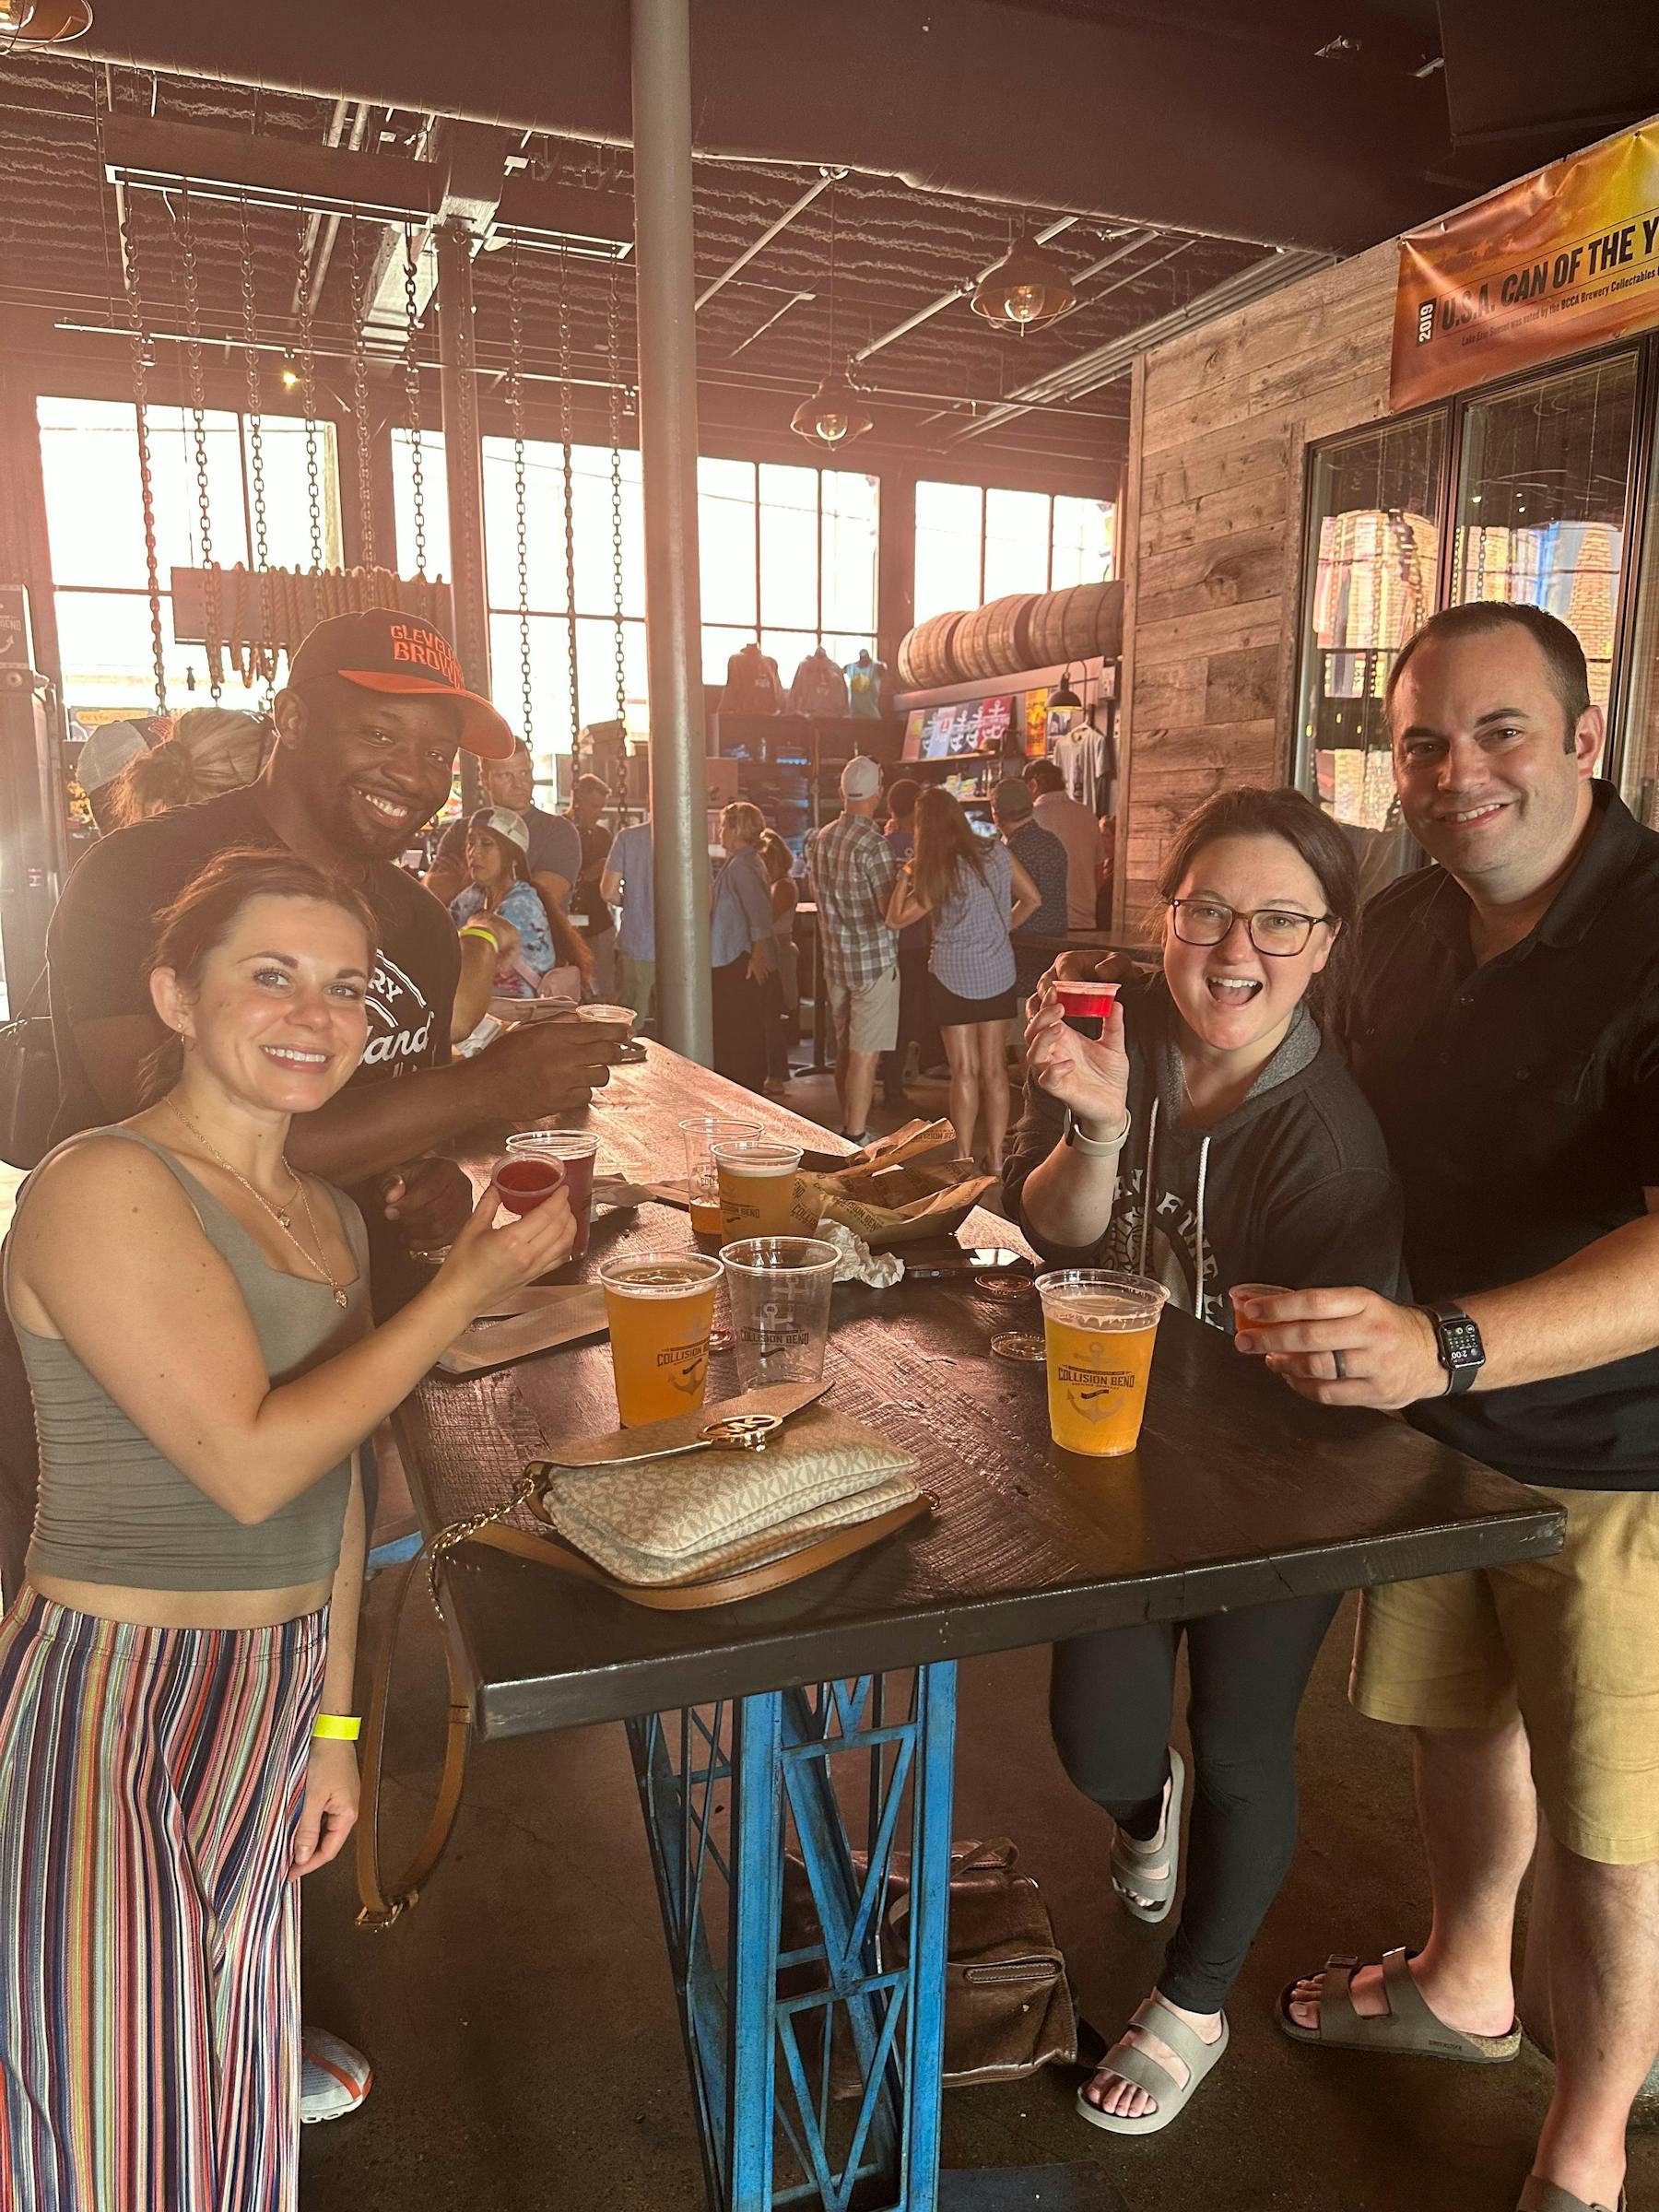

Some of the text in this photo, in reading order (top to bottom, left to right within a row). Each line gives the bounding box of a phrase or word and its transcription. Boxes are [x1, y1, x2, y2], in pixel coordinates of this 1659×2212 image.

[1441, 284, 1495, 331] U.S.A.
[1501, 262, 1548, 306] CAN
[1552, 247, 1583, 288] OF
[1588, 225, 1636, 275] THE
[1540, 307, 1548, 320] by
[1549, 302, 1559, 315] the
[1561, 294, 1580, 312] BCCA
[1581, 286, 1609, 303] Brewery
[1610, 270, 1655, 292] Collectables
[1418, 303, 1434, 342] 2019
[369, 967, 404, 1004] RY
[360, 1010, 435, 1065] and
[792, 1203, 818, 1226] COLLIS
[656, 1345, 702, 1367] COLLISION
[786, 1333, 809, 1346] BEND
[1057, 1367, 1108, 1385] COLLISION
[1112, 1374, 1135, 1388] BEND
